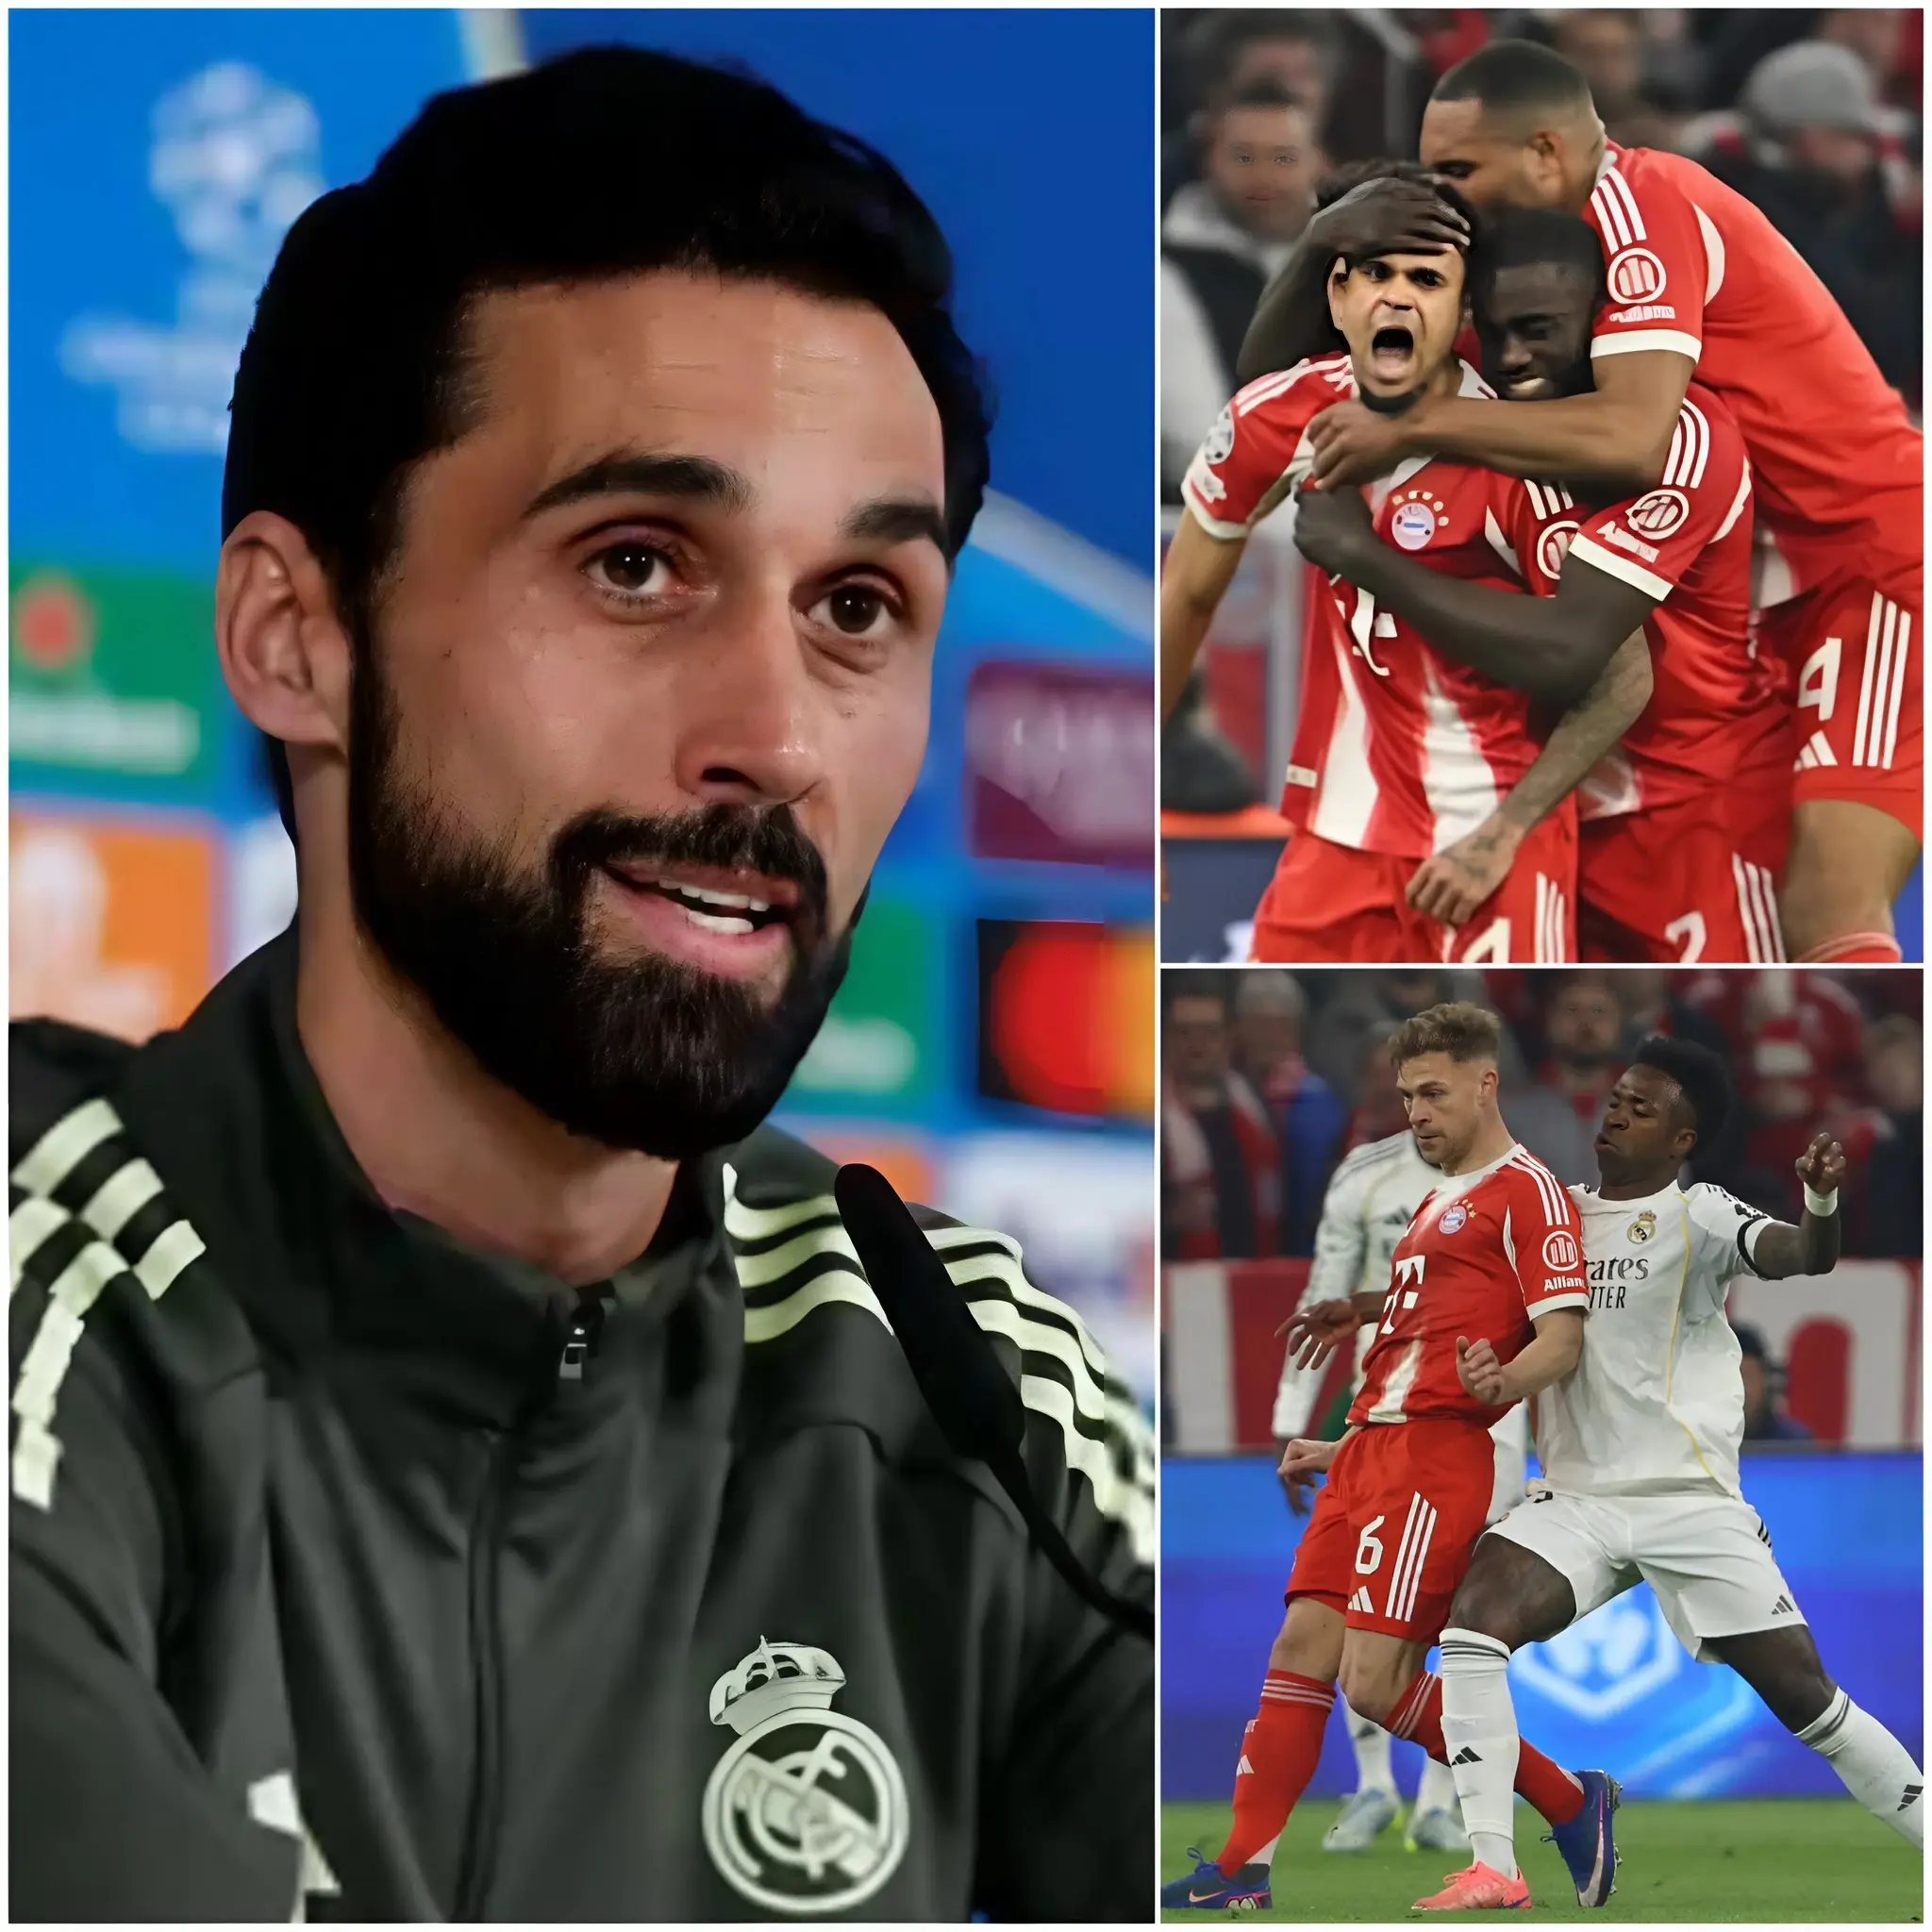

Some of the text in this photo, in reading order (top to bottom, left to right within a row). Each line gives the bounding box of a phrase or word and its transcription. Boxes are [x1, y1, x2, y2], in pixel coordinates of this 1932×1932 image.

[1797, 637, 1842, 722] 4
[1543, 1275, 1586, 1291] Allian
[1355, 1515, 1385, 1575] 6
